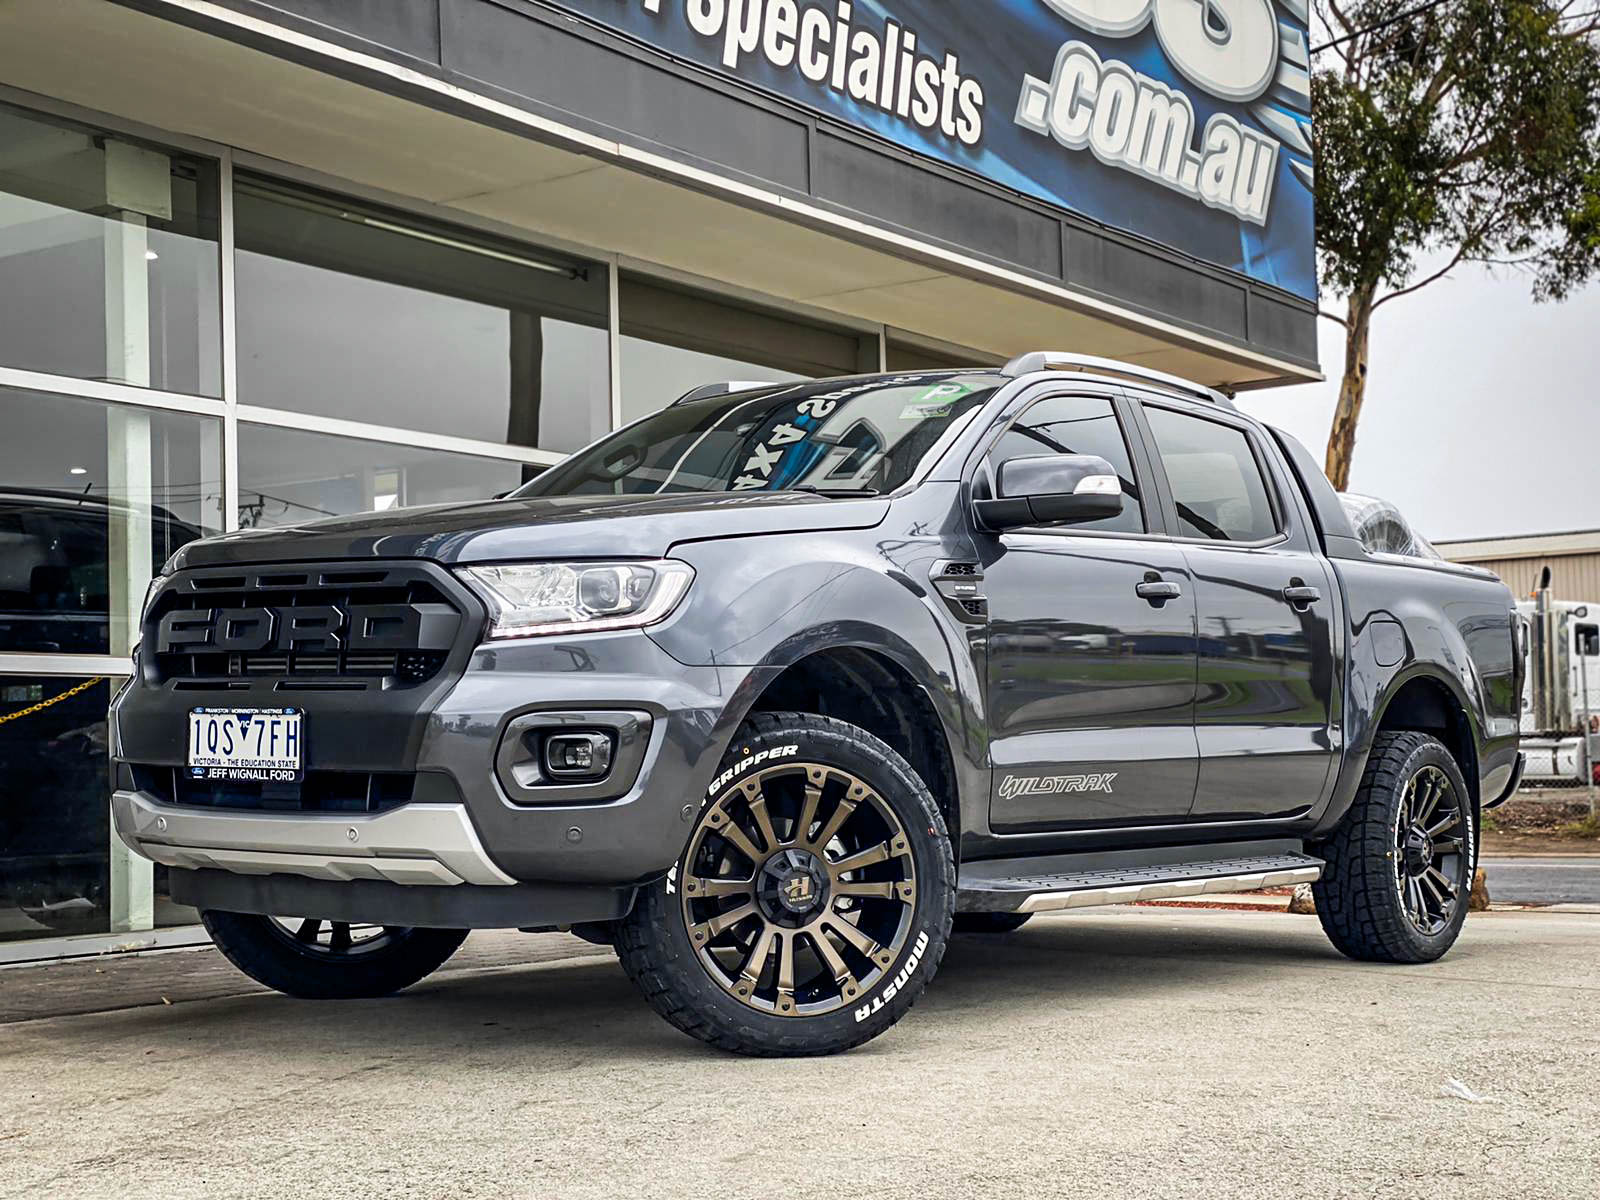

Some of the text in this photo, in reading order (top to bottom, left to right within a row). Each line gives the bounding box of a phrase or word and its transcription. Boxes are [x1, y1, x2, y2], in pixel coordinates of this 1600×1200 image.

[1016, 44, 1279, 224] .com.au
[157, 602, 424, 654] FORD
[195, 719, 298, 757] 1QS 7FH
[208, 768, 228, 778] JEFF
[228, 769, 269, 779] WIGNALL
[270, 770, 295, 780] FORD
[227, 758, 239, 766] THE
[240, 759, 276, 767] EDUCATION
[277, 760, 297, 768] STATE
[708, 744, 799, 796] GRIPPER
[999, 772, 1119, 799] WILDTRAK
[854, 930, 930, 1022] MONSTA
